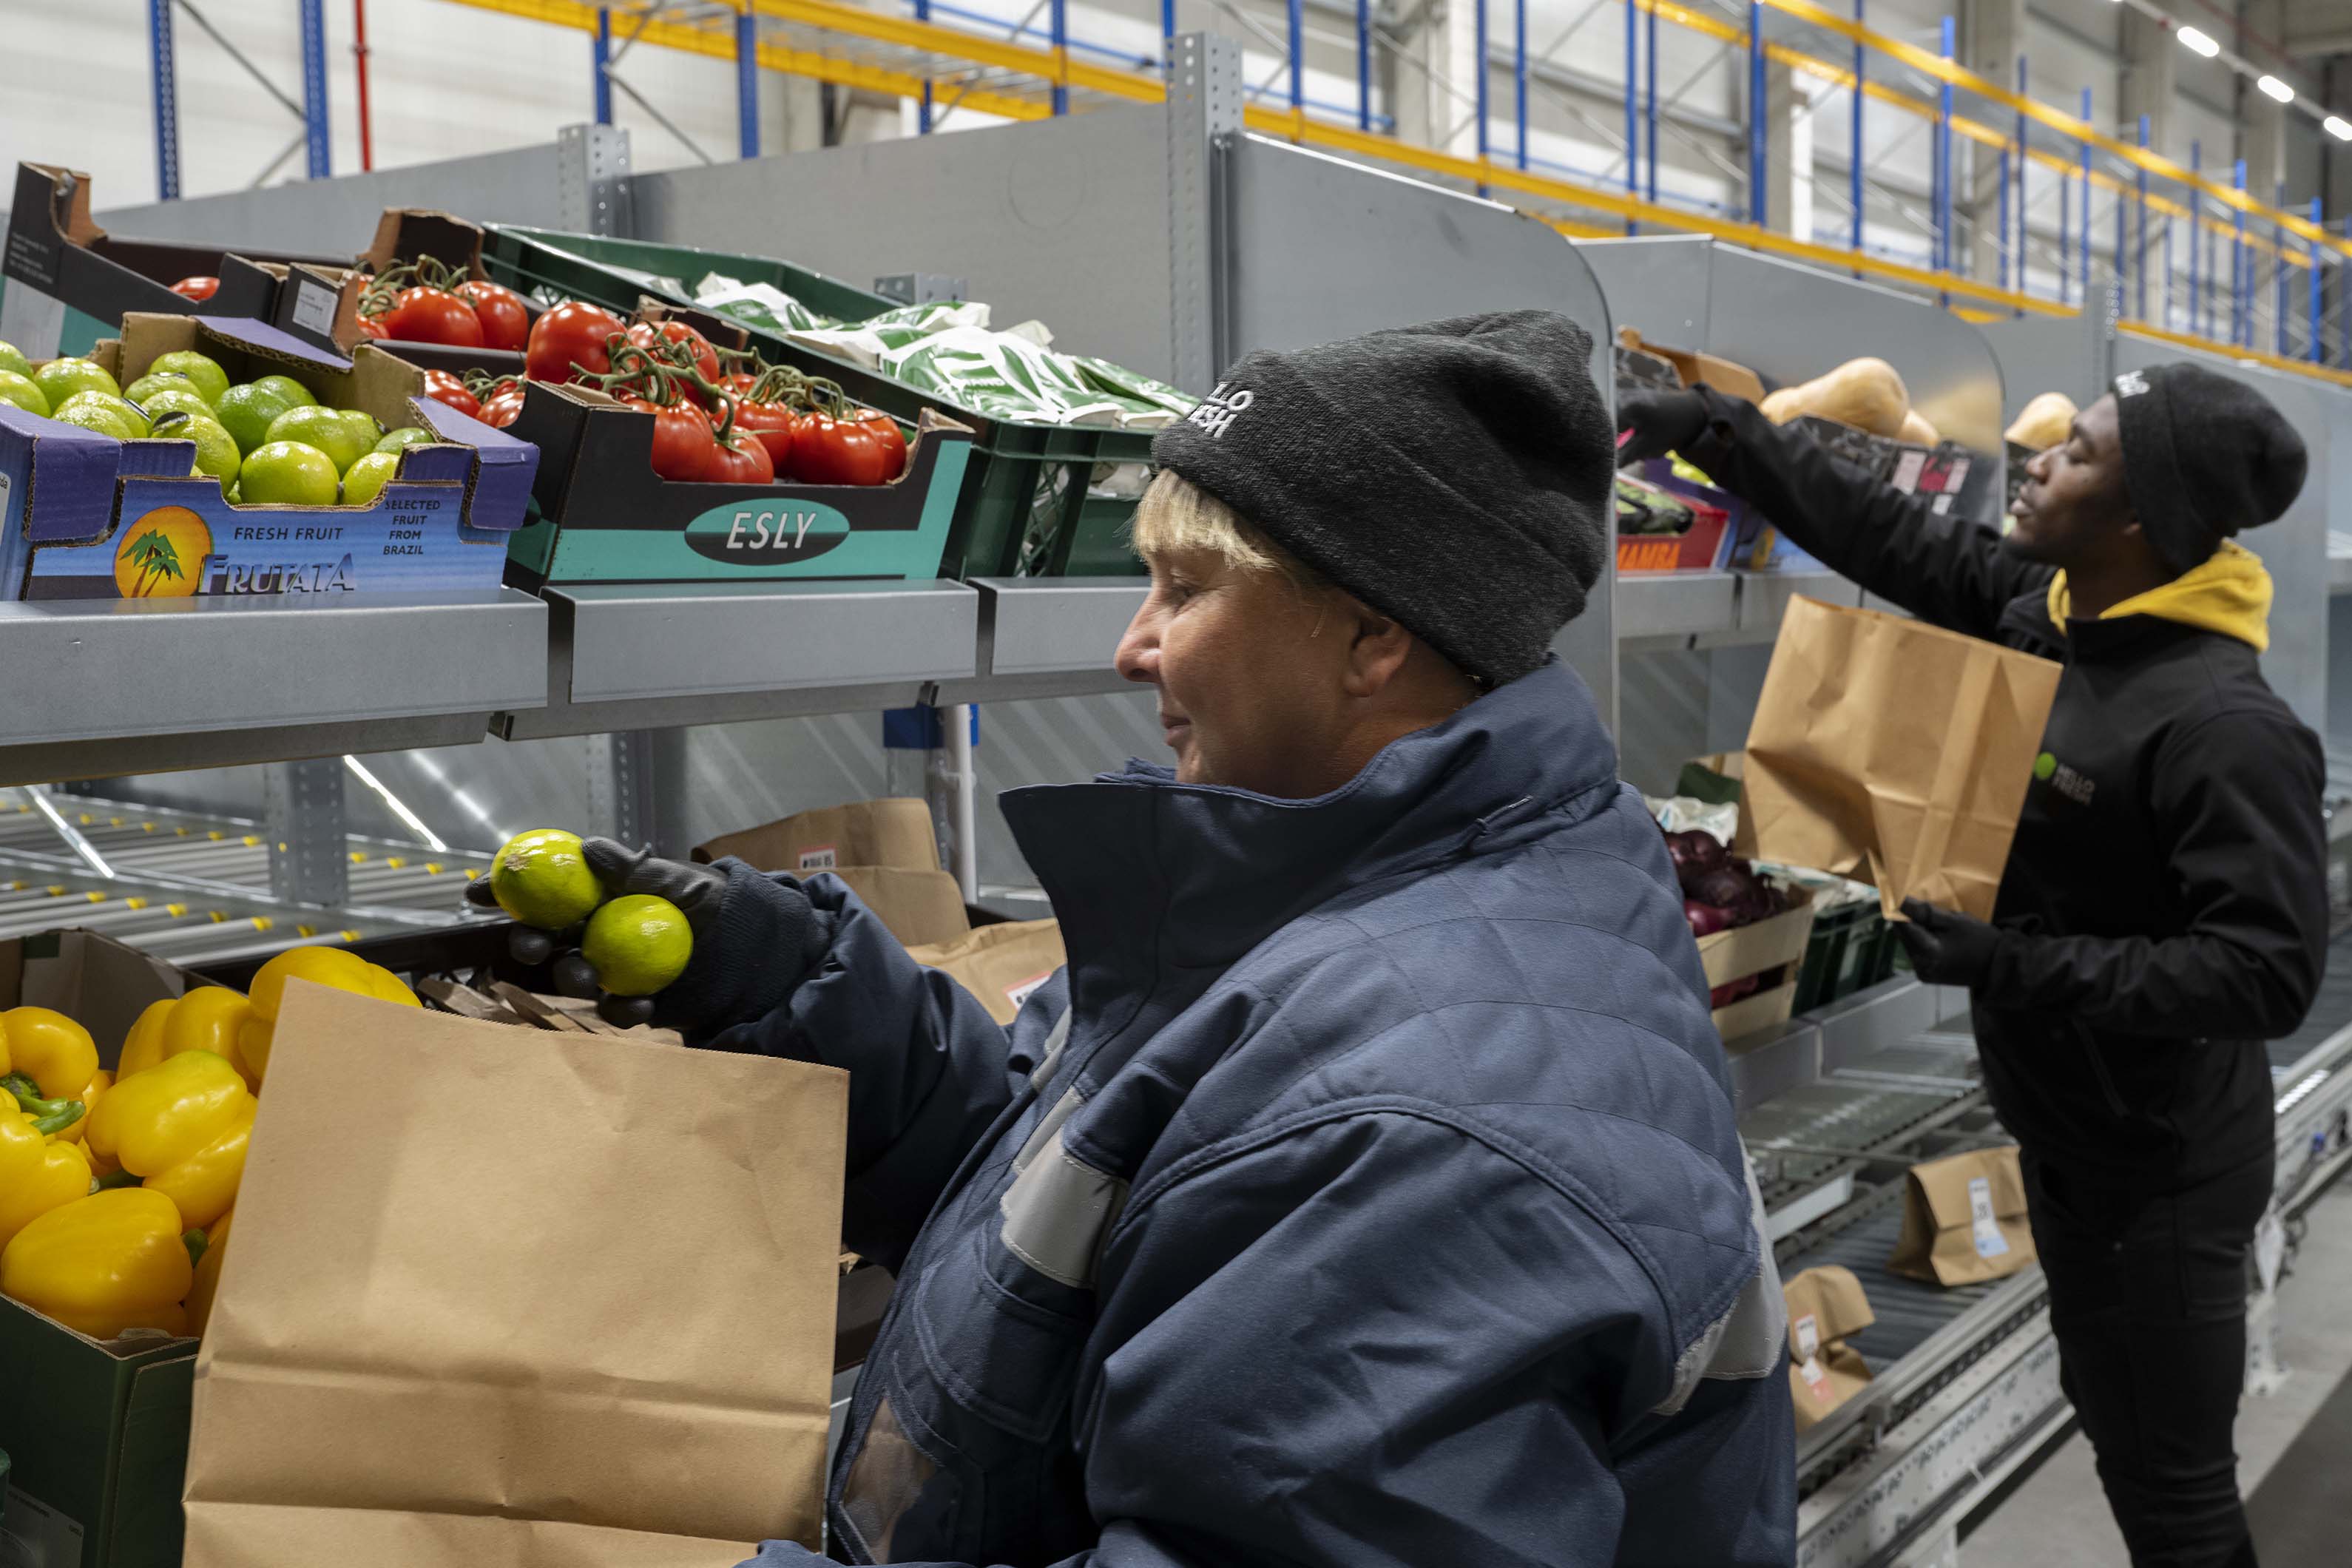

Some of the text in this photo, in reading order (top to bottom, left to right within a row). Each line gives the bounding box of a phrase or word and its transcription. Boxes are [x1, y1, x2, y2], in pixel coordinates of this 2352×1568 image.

[385, 499, 441, 510] SELECTED
[392, 515, 428, 525] FRUIT
[234, 527, 344, 540] FRESH FRUIT
[388, 530, 422, 540] FROM
[726, 512, 817, 549] ESLY
[383, 545, 424, 555] BRAZIL
